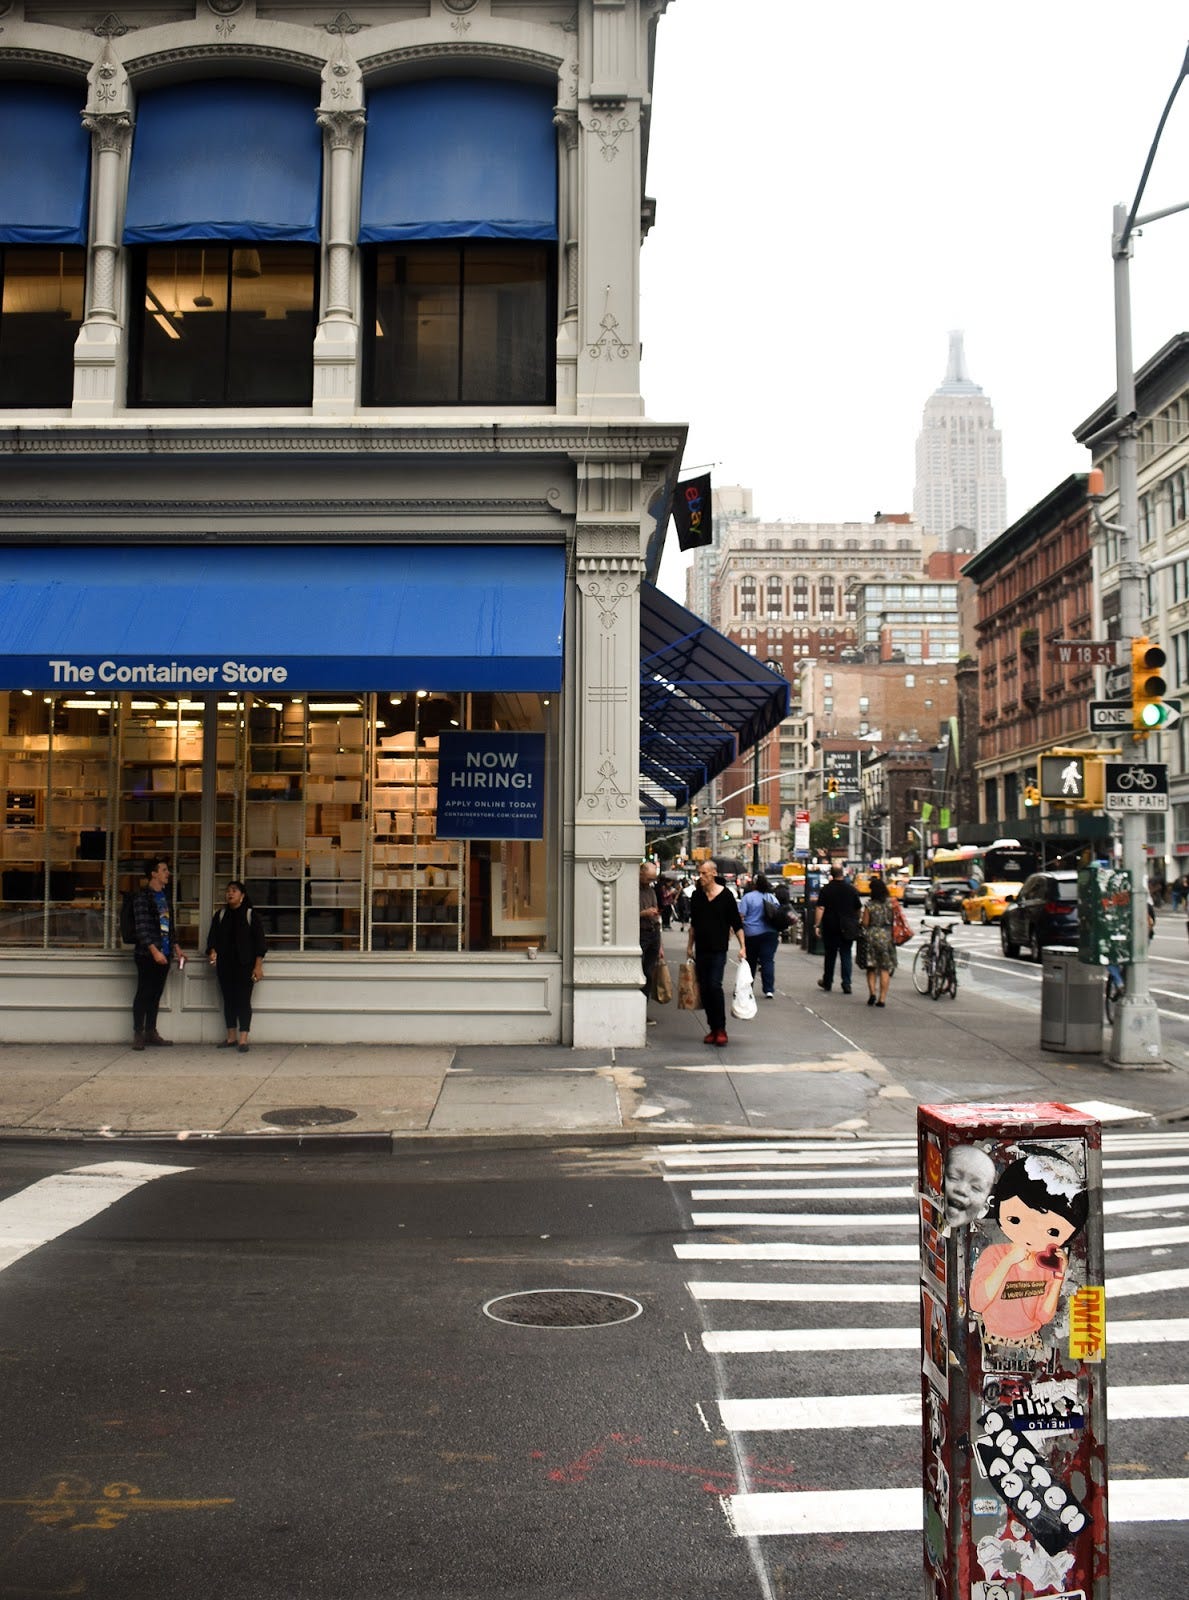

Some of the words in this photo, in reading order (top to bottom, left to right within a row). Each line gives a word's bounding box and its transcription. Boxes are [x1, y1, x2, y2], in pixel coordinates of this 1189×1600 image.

[685, 487, 703, 534] ebay
[1060, 647, 1071, 662] W
[1077, 648, 1091, 662] 18
[1097, 648, 1111, 663] St
[49, 661, 95, 683] The
[99, 661, 218, 683] Container
[221, 661, 288, 683] Store
[1098, 711, 1126, 722] ONE
[466, 752, 519, 768] NOW
[451, 771, 533, 788] HIRING!
[1110, 795, 1133, 807] BIKE
[1138, 795, 1165, 807] PATH
[444, 811, 538, 819] CONTAINERSTORE.COM/CAREERS
